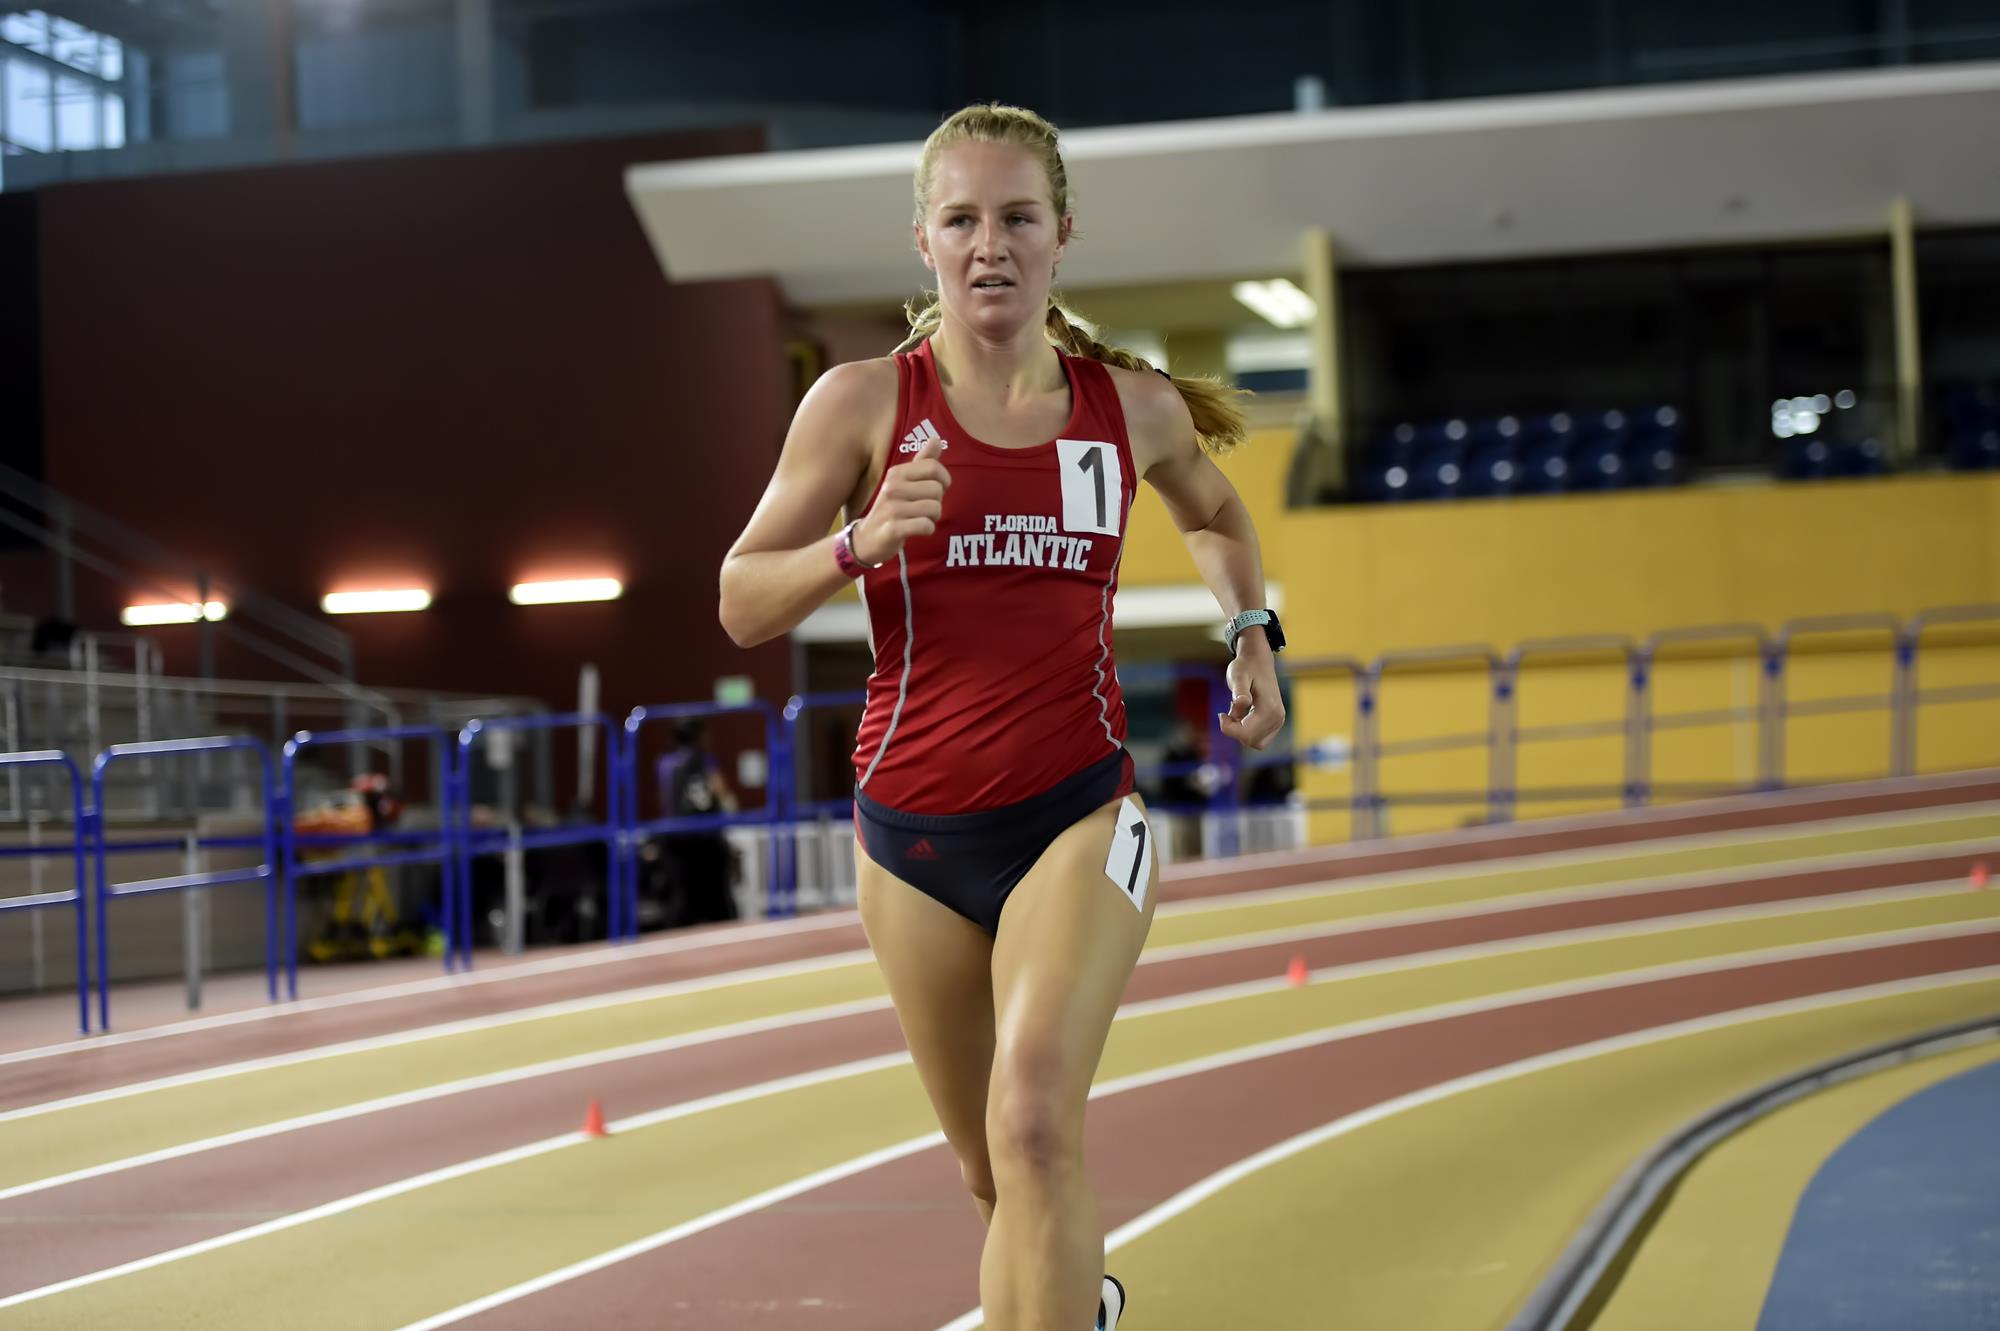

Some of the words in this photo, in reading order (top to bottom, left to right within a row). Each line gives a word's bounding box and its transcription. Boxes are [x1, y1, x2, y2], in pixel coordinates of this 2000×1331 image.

[899, 438, 948, 453] adis
[1077, 446, 1106, 528] 1
[984, 514, 1057, 533] FLORIDA
[946, 533, 1092, 572] ATLANTIC
[1127, 820, 1146, 895] 1
